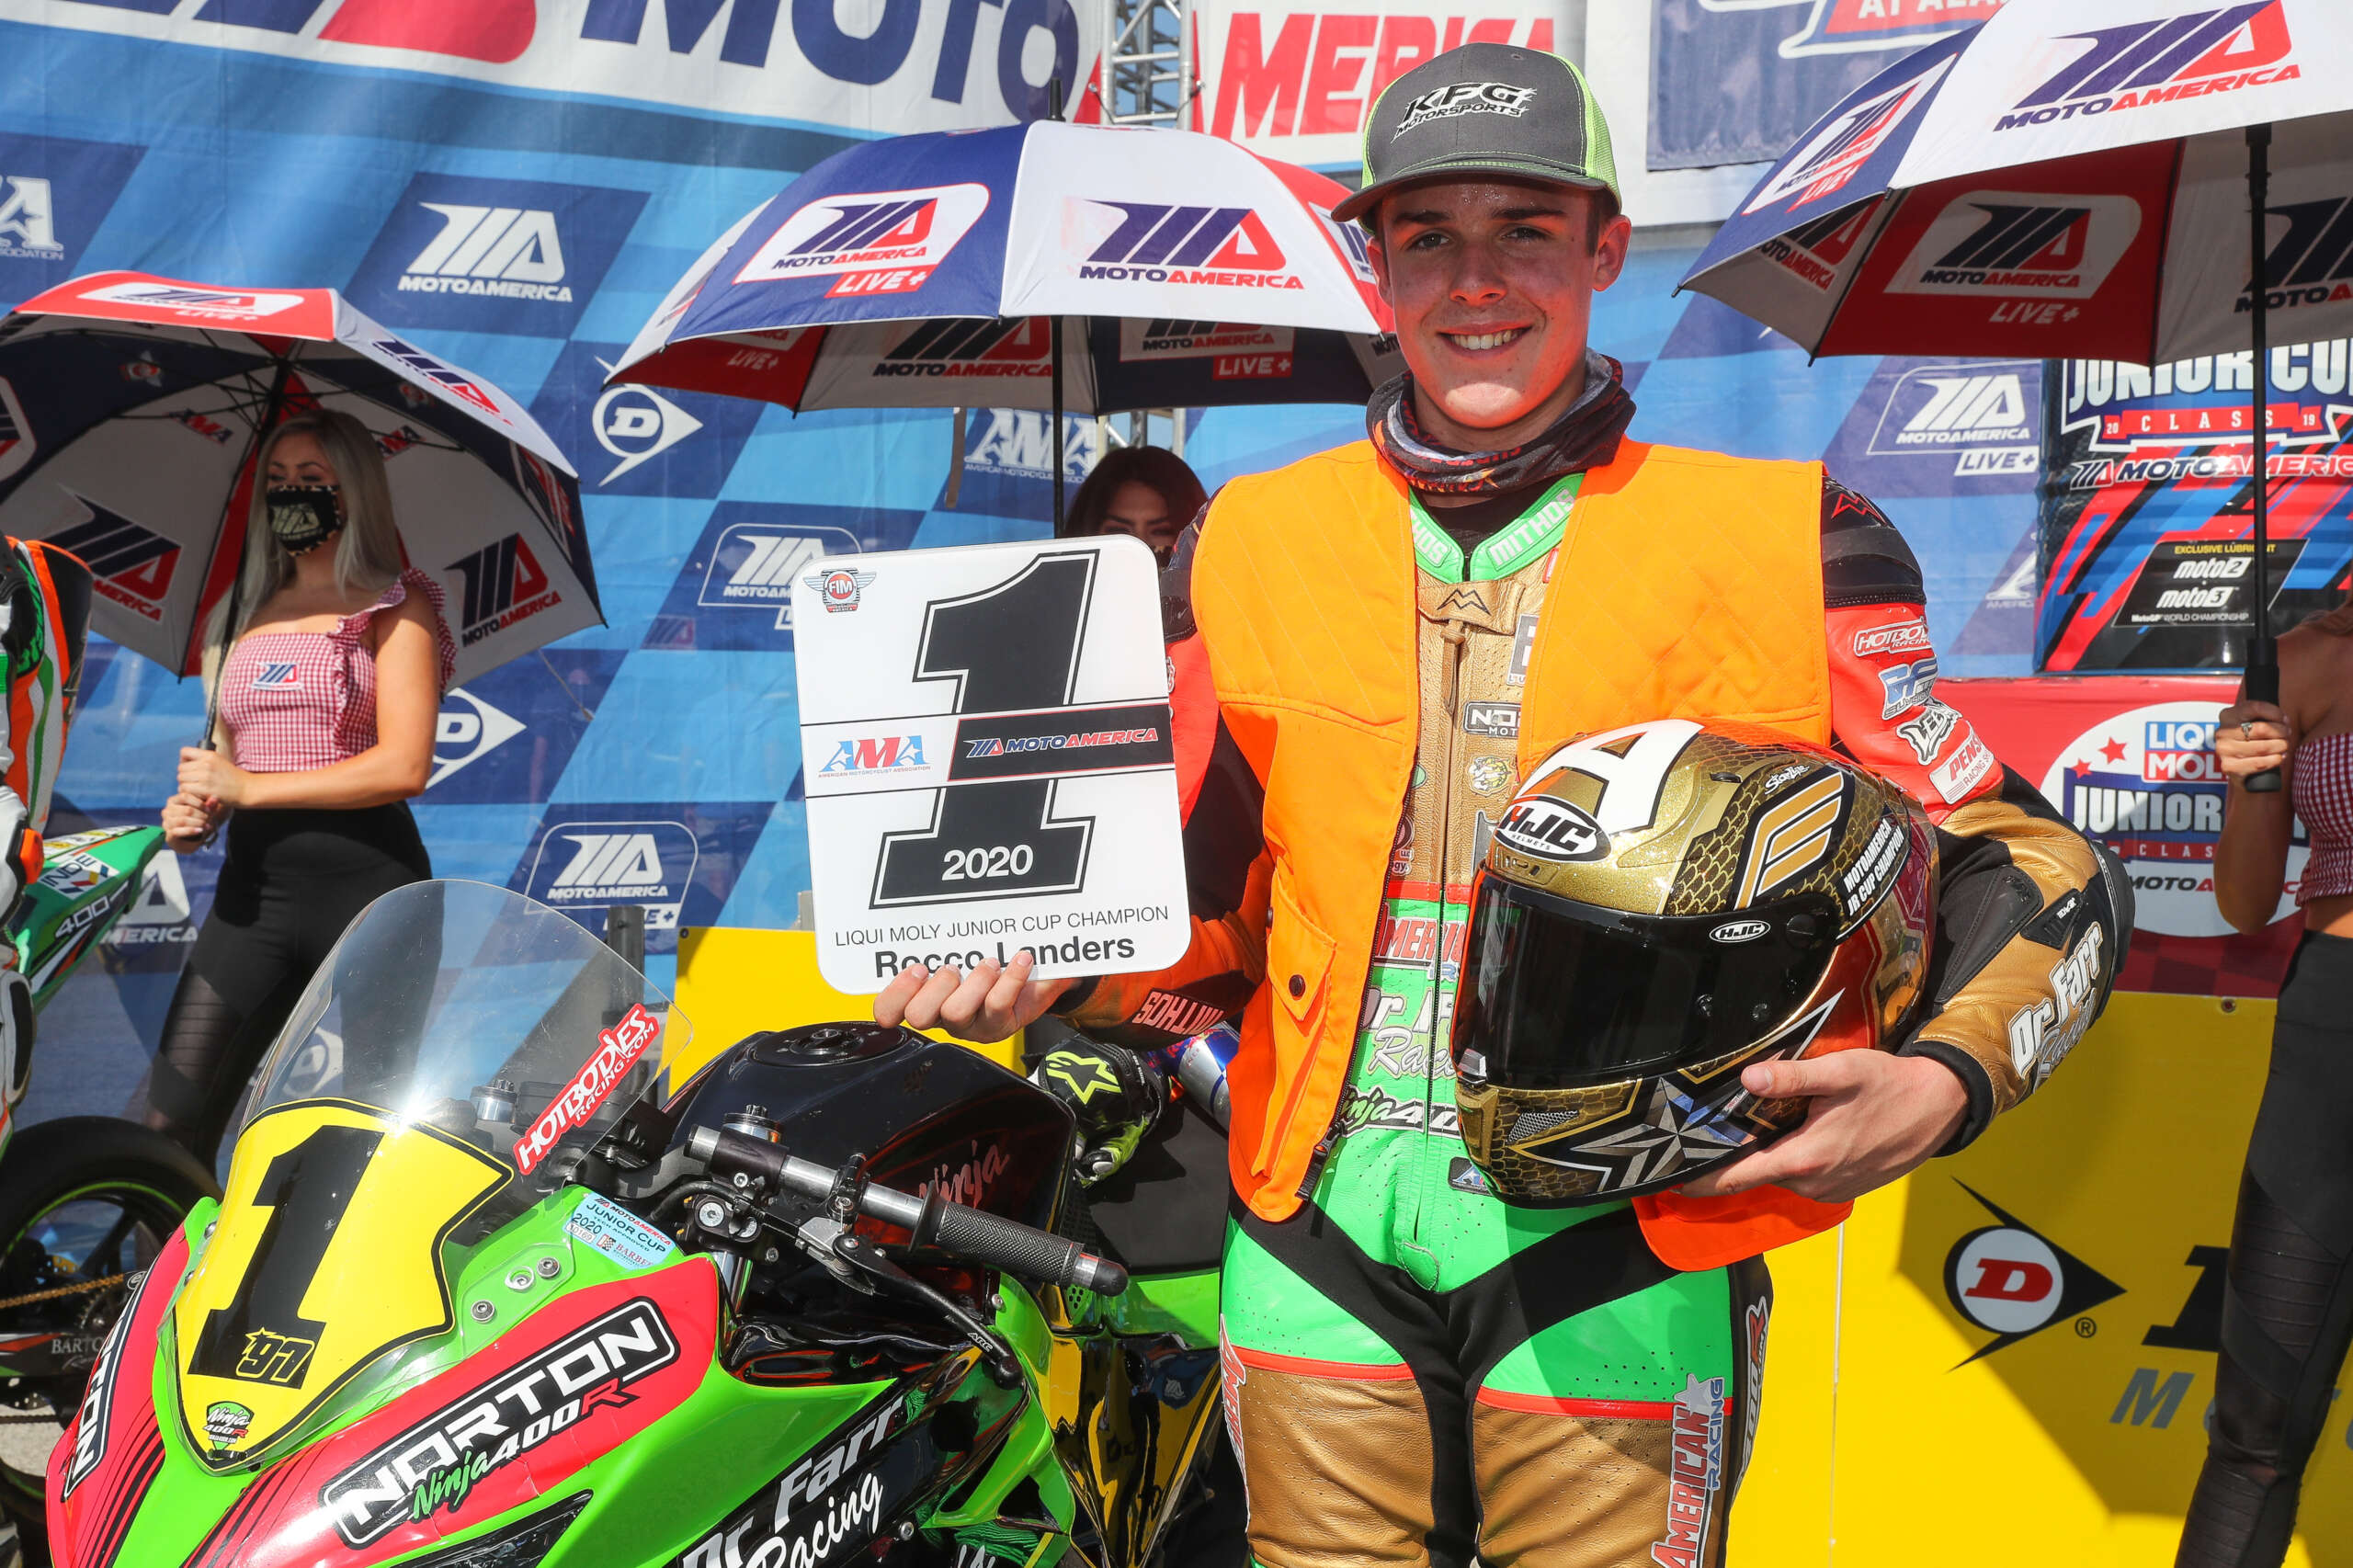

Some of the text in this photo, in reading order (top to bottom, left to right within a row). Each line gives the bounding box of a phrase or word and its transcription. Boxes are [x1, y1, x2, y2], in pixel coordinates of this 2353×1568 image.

[1401, 82, 1528, 123] KFG
[1993, 64, 2301, 131] MOTOAMERICA
[1396, 102, 1524, 136] MOTORSPORTS
[772, 246, 927, 269] MOTOAMERICA
[397, 275, 574, 302] MOTOAMERICA
[1079, 266, 1305, 290] MOTOAMERICA
[1920, 268, 2081, 288] MOTOAMERICA
[1142, 334, 1275, 350] MOTOAMERICA
[872, 363, 1053, 378] MOTOAMERICA
[1895, 427, 2030, 445] MOTOAMERICA
[2106, 422, 2119, 435] 20
[2302, 414, 2315, 426] 19
[1488, 488, 1576, 566] MITHOS
[2174, 544, 2222, 555] EXCLUSIVE
[828, 579, 854, 596] FIM
[461, 589, 563, 648] MOTOAMERICA
[2163, 612, 2189, 622] WORLD
[2190, 612, 2250, 622] CHAMPIONSHIP
[819, 735, 930, 773] AMA
[1006, 727, 1159, 753] MOTOAMERICA
[818, 765, 931, 778] AMERICAN MOTORCYCLIST ASSOCIATION
[2074, 784, 2222, 833] JUNIOR
[1499, 805, 1596, 852] HJC
[1511, 834, 1552, 851] HELMETS
[941, 844, 1034, 881] 2020
[1843, 817, 1893, 893] MOTOAMERICA
[1847, 824, 1905, 917] JR CUP CHAMPION
[547, 885, 669, 901] MOTOAMERICA
[835, 904, 1169, 947] LIQUI MOLY JUNIOR CUP CHAMPION
[1718, 922, 1765, 942] HJC
[2009, 1001, 2053, 1079] Dr
[2050, 924, 2103, 1027] Farr
[517, 1008, 646, 1170] HOTBODIES
[574, 1022, 655, 1121] RACING.COM
[572, 1212, 603, 1234] 2020
[586, 1202, 666, 1253] JUNIOR CUP
[609, 1205, 672, 1246] MOTOAMERICA
[187, 1125, 387, 1391] 1
[1964, 1257, 2054, 1303] D
[235, 1327, 315, 1383] 97
[967, 1333, 994, 1353] ARC
[202, 1424, 249, 1439] 400R
[207, 1406, 250, 1426] Ninja
[338, 1315, 659, 1527] NORTON
[1708, 1377, 1724, 1490] RACING
[774, 1394, 904, 1535] Farr
[1654, 1405, 1711, 1568] AMERICAN
[746, 1471, 884, 1568] Racing
